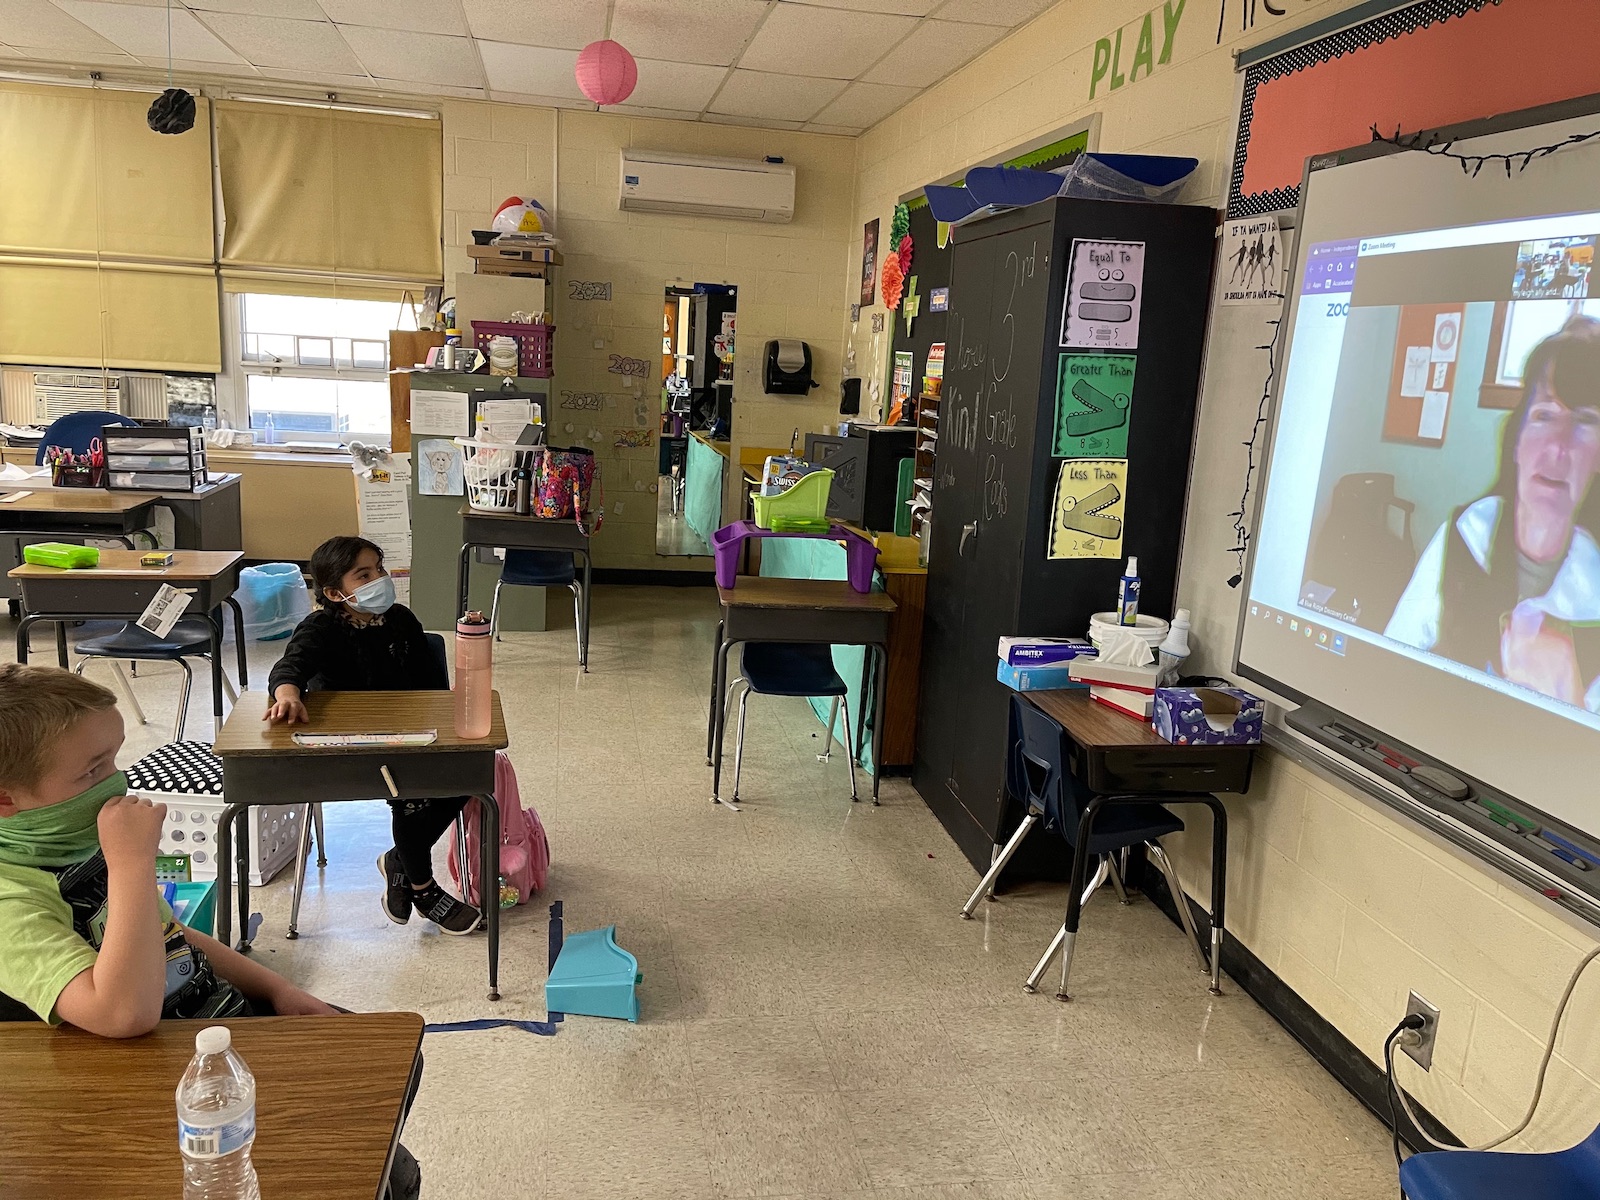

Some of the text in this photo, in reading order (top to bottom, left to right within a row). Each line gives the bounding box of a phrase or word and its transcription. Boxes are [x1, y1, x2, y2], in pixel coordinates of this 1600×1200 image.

[1089, 0, 1186, 100] PLAY
[1249, 223, 1267, 235] WANTED
[1089, 249, 1131, 267] Equal To
[568, 280, 612, 301] 2021
[993, 241, 1037, 382] 3rd
[1326, 302, 1350, 317] zoo
[1088, 327, 1119, 340] 5 5
[607, 354, 651, 379] 2021
[1070, 363, 1133, 376] Greater Than
[561, 390, 604, 411] 2021
[945, 386, 980, 454] Kind
[985, 381, 1017, 450] Grade
[1070, 467, 1118, 480] Less Than
[1073, 540, 1104, 551] 2 7
[1304, 599, 1357, 623] Blue Ridge Discovery Center
